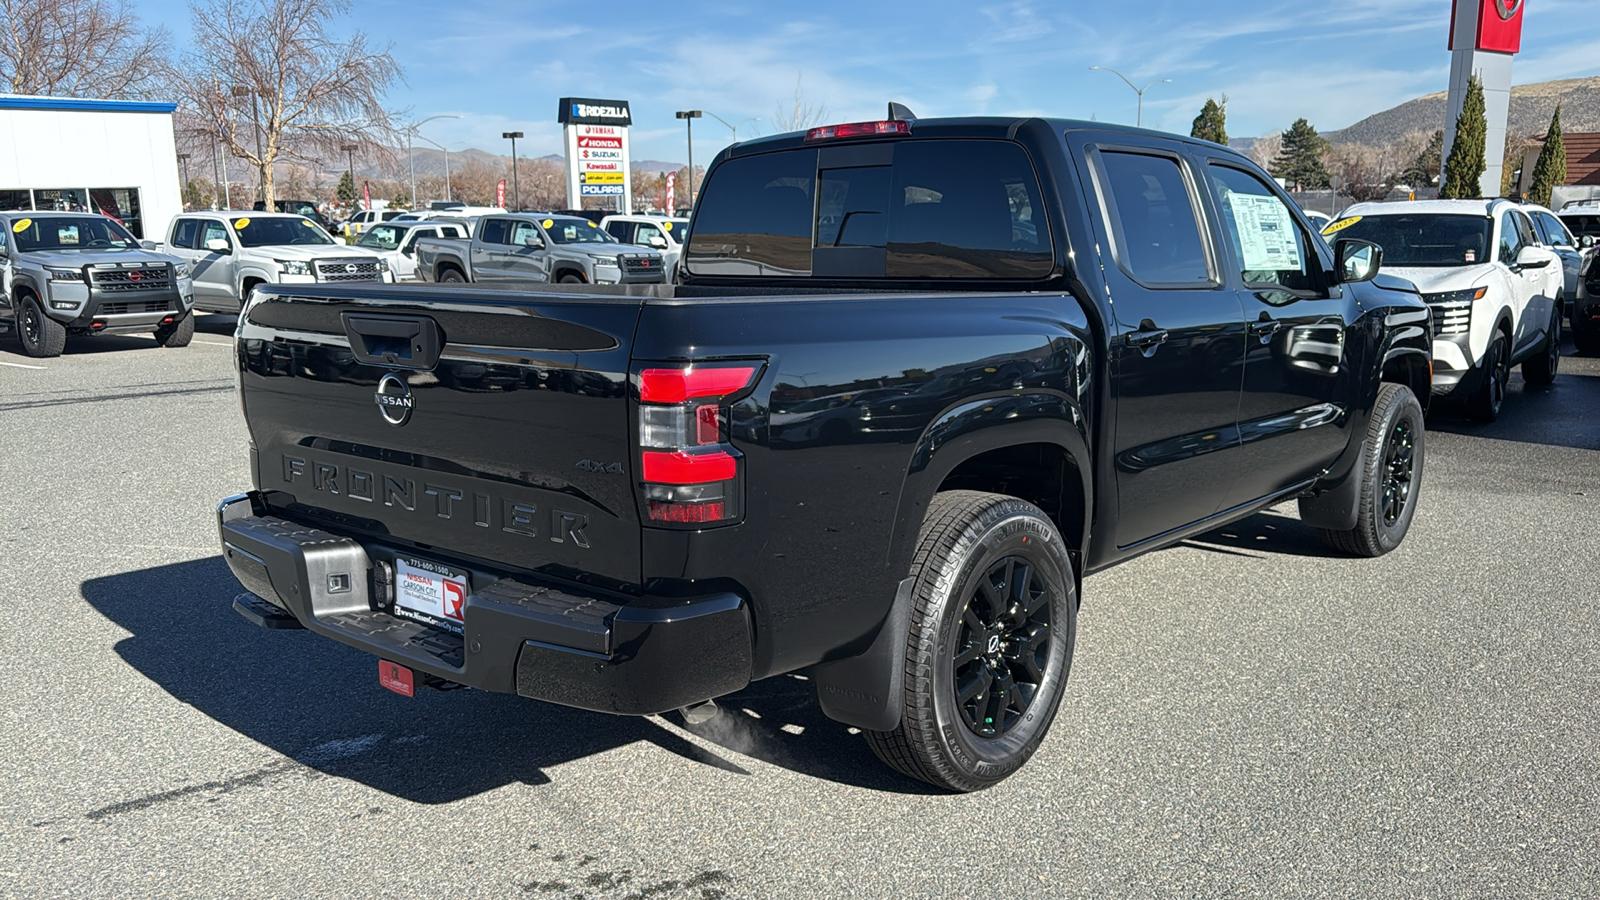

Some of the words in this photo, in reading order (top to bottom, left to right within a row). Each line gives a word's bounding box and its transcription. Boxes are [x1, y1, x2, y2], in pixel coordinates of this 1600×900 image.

[586, 105, 629, 118] RIDEZILLA
[582, 186, 624, 194] POLARIS
[1331, 218, 1354, 232] 2025
[375, 394, 412, 407] NISSAN
[282, 454, 590, 548] FRONTIER
[410, 559, 449, 575] 775-600-1500
[407, 573, 433, 586] NISSAN
[403, 580, 425, 593] CARSON
[425, 587, 437, 597] CITY
